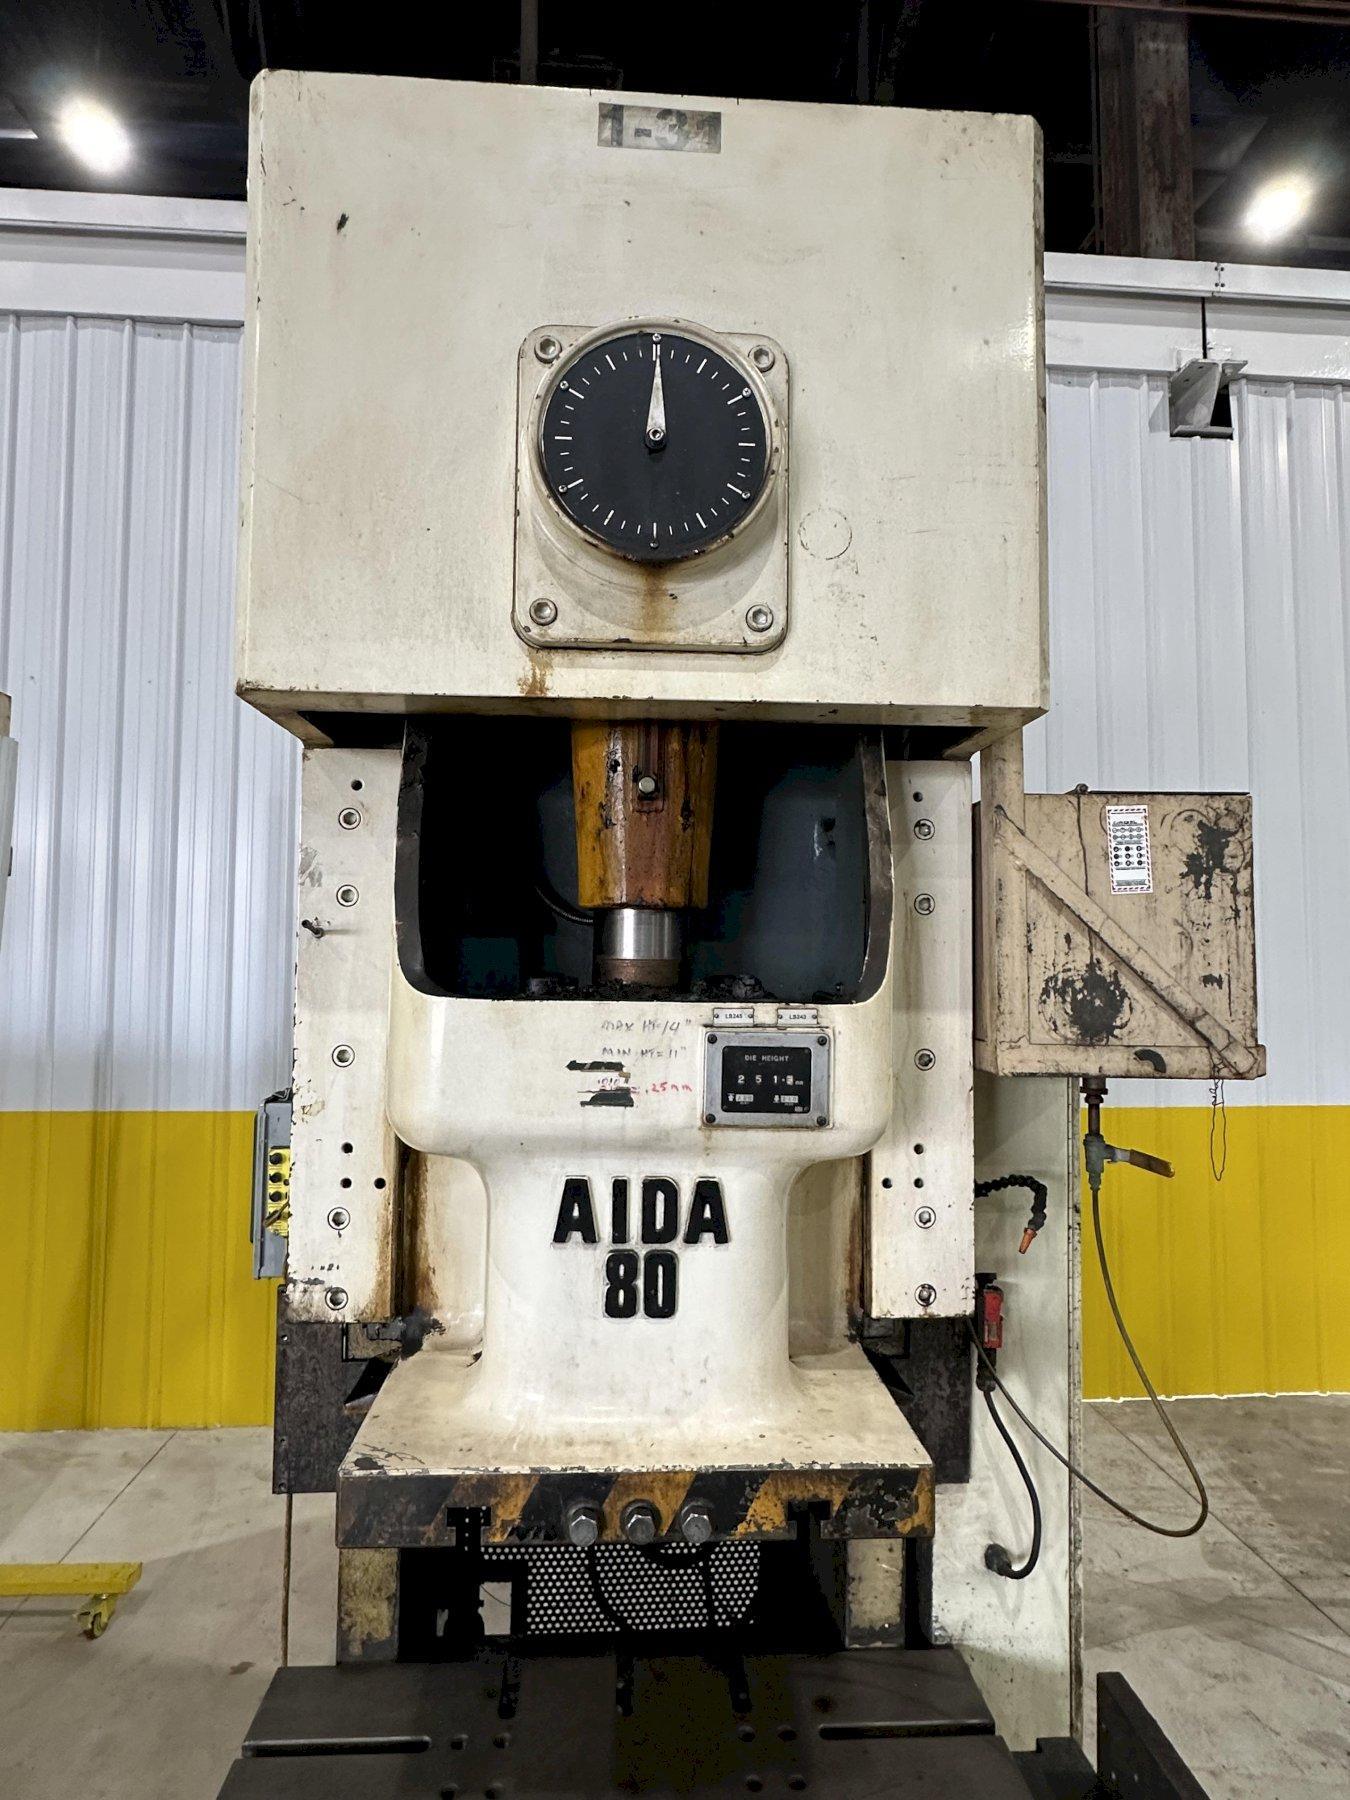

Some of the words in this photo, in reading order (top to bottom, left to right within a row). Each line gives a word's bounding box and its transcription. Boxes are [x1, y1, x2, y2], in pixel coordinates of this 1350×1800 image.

[744, 1054, 757, 1062] DIE
[552, 1176, 730, 1245] AIDA
[604, 1250, 679, 1319] 80
